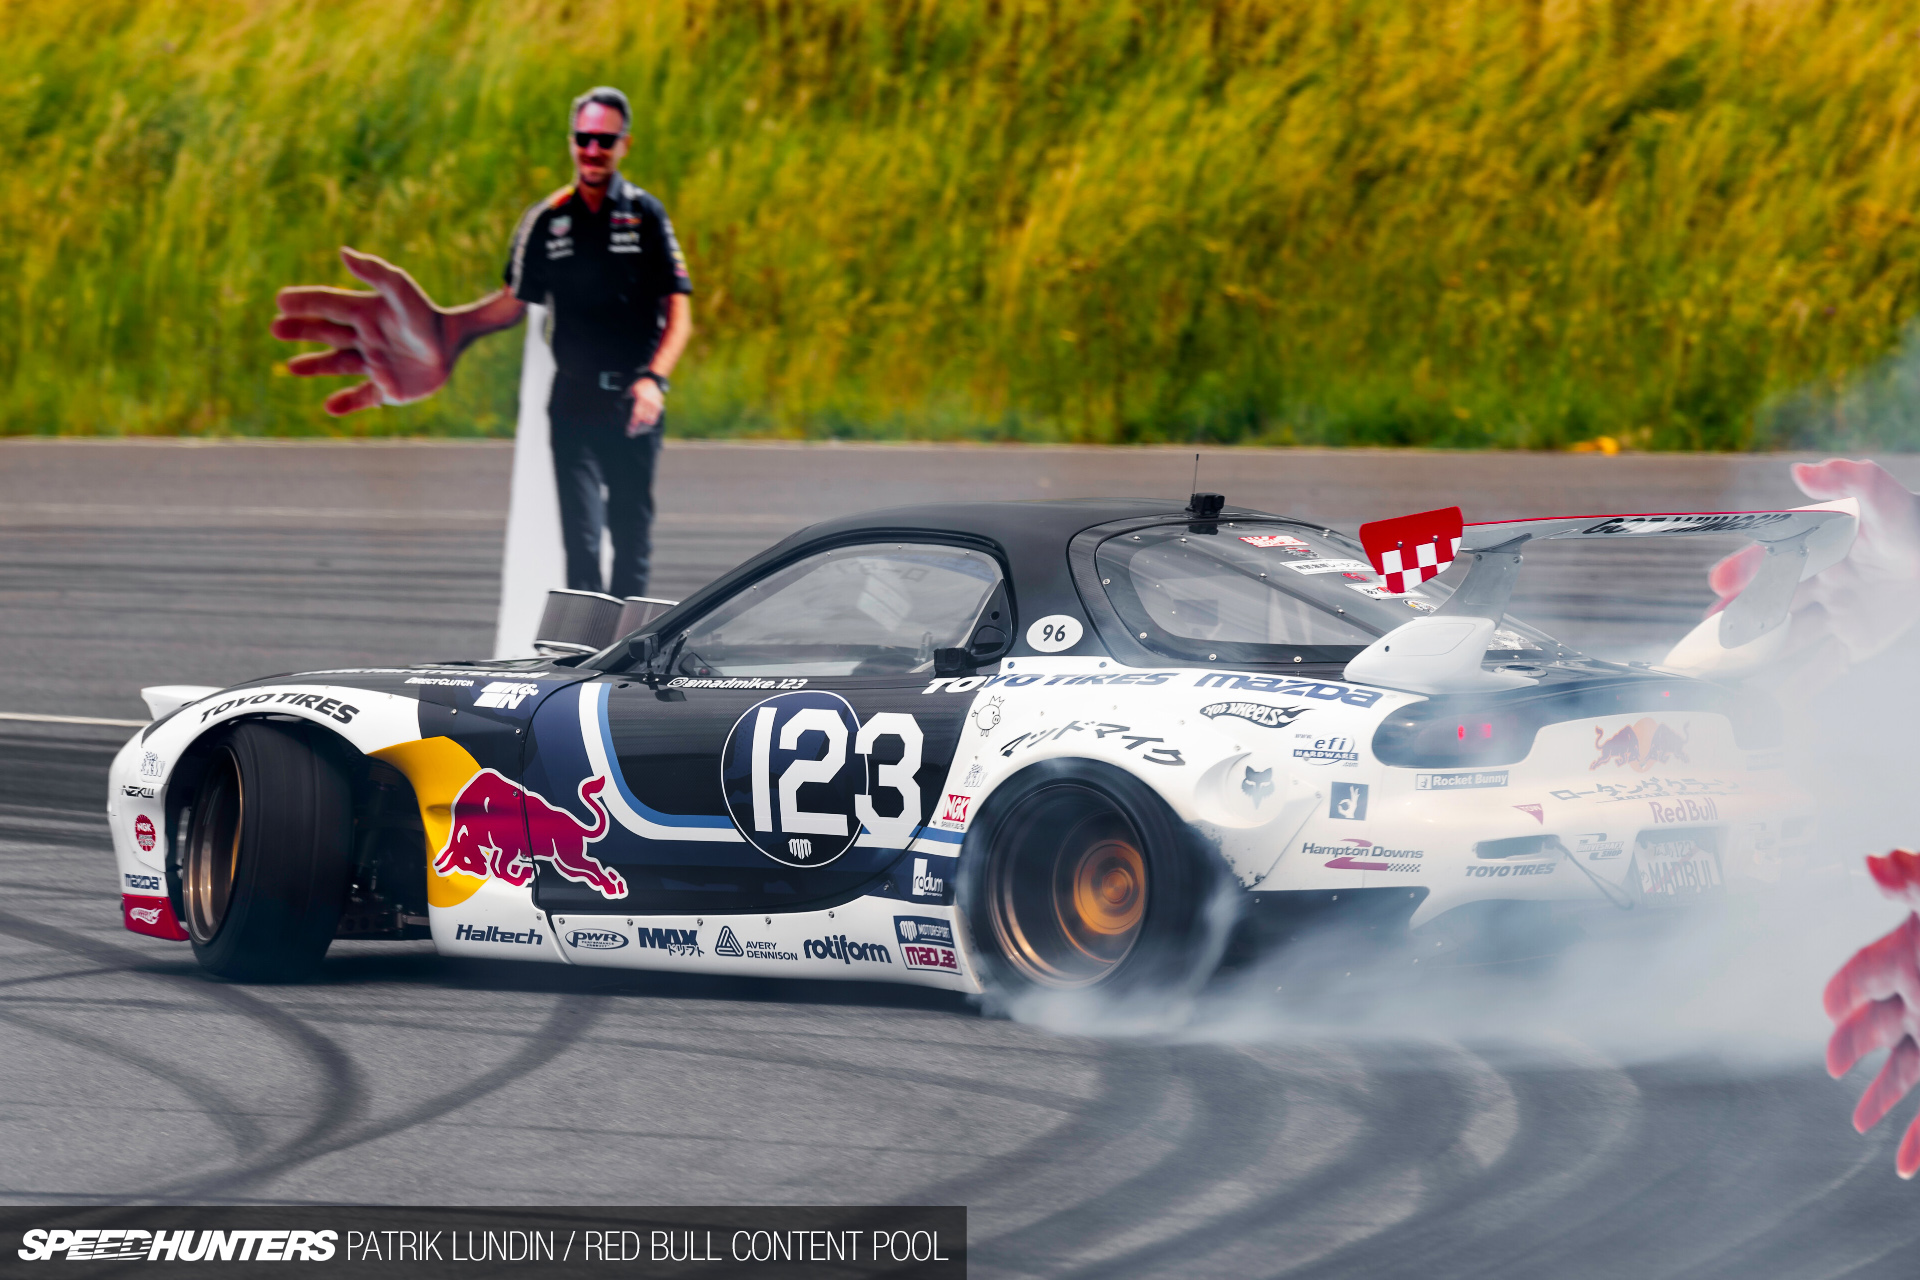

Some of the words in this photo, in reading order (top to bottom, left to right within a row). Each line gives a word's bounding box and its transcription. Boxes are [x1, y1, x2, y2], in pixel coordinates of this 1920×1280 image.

[1043, 624, 1065, 642] 96
[921, 673, 1046, 694] TOYO
[1043, 672, 1180, 687] TIRES
[200, 693, 277, 724] TOYO
[275, 692, 361, 725] TIRES
[1314, 737, 1347, 751] efi
[1294, 750, 1357, 760] HARDWARE
[750, 705, 925, 842] 123
[1432, 774, 1473, 787] Rocket
[1474, 772, 1508, 787] Bunny
[943, 796, 969, 822] NGK
[1648, 799, 1687, 824] Red
[1684, 797, 1719, 821] Bull
[136, 822, 153, 832] NGK
[1302, 842, 1369, 858] Hampton
[1371, 846, 1424, 859] Downs
[1601, 850, 1623, 862] SHOP
[1465, 865, 1509, 878] TOYO
[1511, 863, 1557, 876] TIRES
[455, 924, 543, 945] Haltech
[638, 927, 699, 950] MAX
[917, 924, 951, 939] MOTORSPORT
[666, 944, 705, 958] ドリフト
[745, 941, 778, 951] AVERY
[803, 935, 893, 964] rotiform
[746, 951, 799, 961] DENNISON
